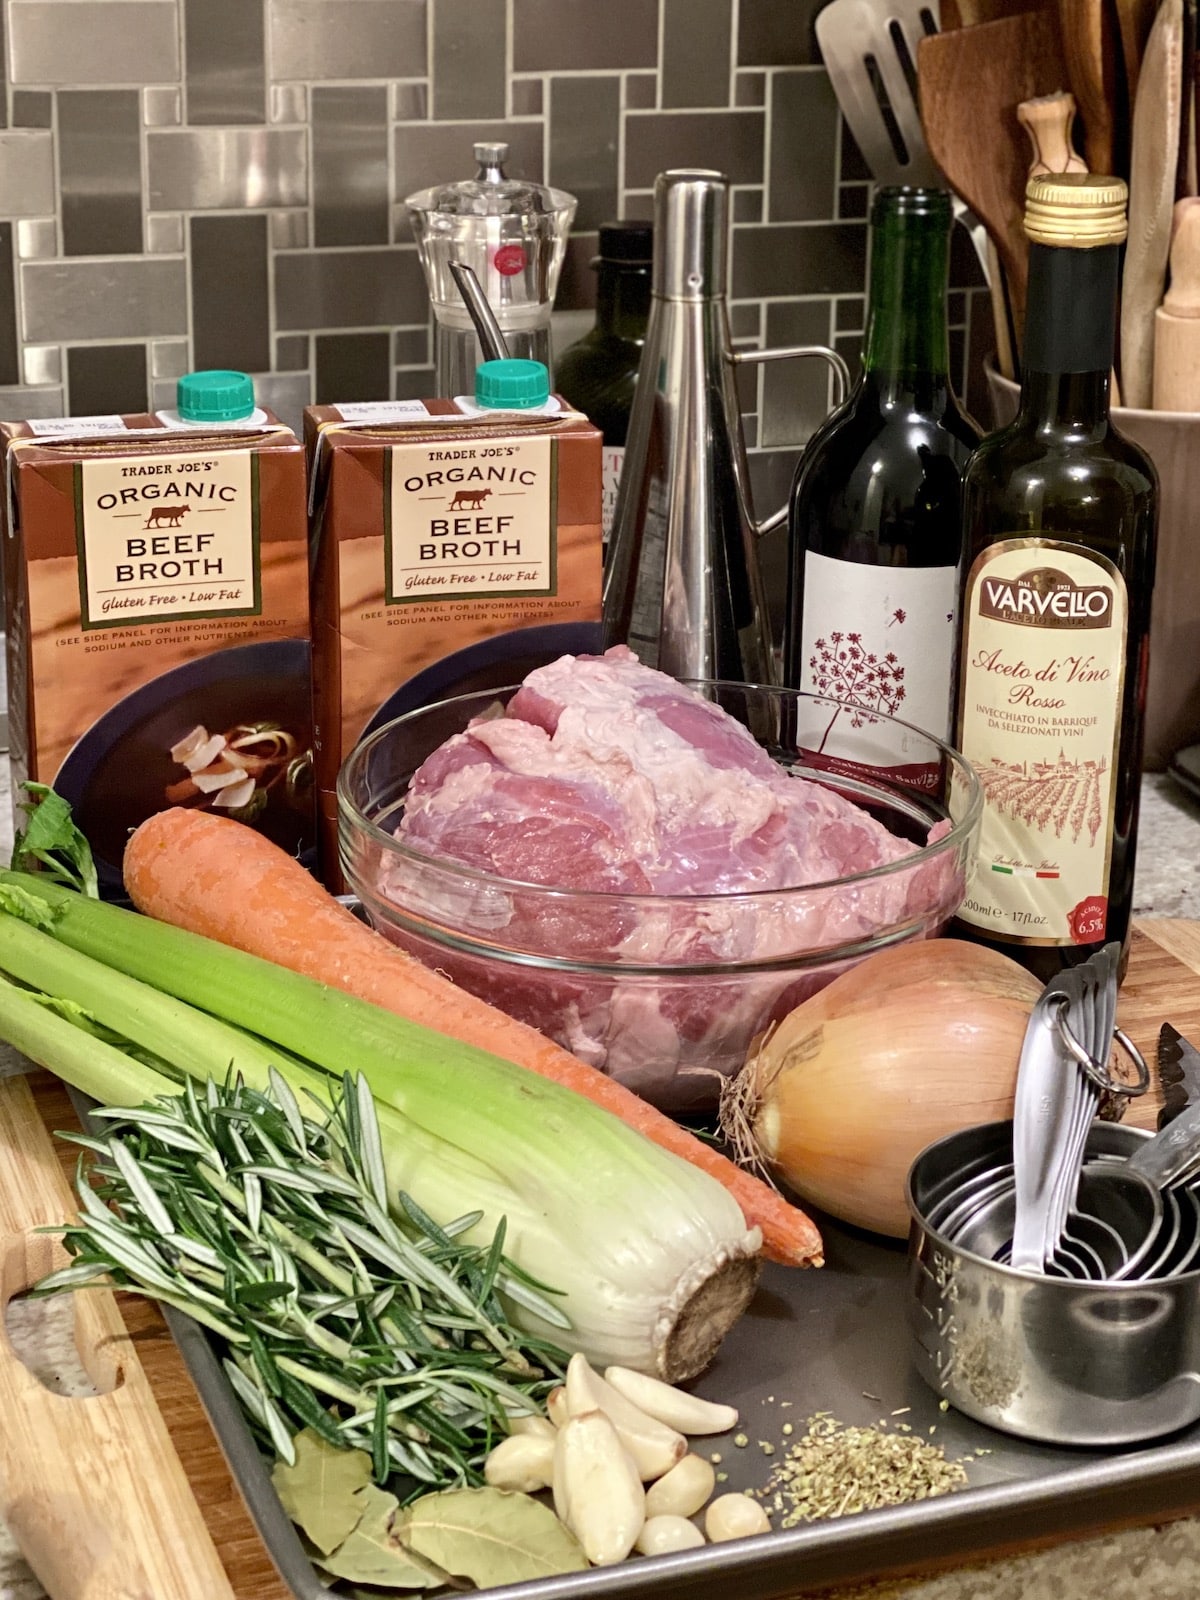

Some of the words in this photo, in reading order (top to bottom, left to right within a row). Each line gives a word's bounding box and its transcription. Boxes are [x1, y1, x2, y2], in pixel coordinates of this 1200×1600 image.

[428, 450, 476, 461] TRADER
[480, 447, 514, 458] JOE'S
[121, 464, 172, 477] TRADER
[177, 461, 213, 473] JOE'S
[404, 466, 537, 492] ORGANIC
[97, 481, 237, 509] ORGANIC
[430, 515, 514, 537] BEEF
[127, 533, 215, 557] BEEF
[419, 539, 521, 561] BROTH
[116, 558, 223, 582] BROTH
[405, 575, 447, 590] Gluten
[450, 573, 477, 584] Free
[488, 571, 514, 582] Low
[516, 570, 539, 581] Fat
[101, 595, 146, 613] Gluten
[149, 593, 177, 605] Free
[189, 591, 216, 602] Low
[218, 588, 242, 600] Fat
[361, 610, 383, 621] (SEE
[386, 608, 409, 617] SIDE
[413, 605, 446, 614] PANEL
[450, 603, 470, 611] FOR
[473, 601, 544, 610] INFORMATION
[547, 600, 582, 608] ABOUT
[986, 581, 1108, 617] VARVELLO
[387, 616, 426, 626] SODIUM
[454, 613, 488, 621] OTHER
[55, 637, 80, 647] (SEE
[84, 633, 109, 643] SIDE
[112, 630, 146, 639] PANEL
[150, 627, 172, 635] FOR
[175, 621, 248, 632] INFORMATION
[252, 619, 288, 627] ABOUT
[84, 642, 127, 653] SODIUM
[129, 639, 152, 648] AND
[155, 635, 191, 645] OTHER
[972, 649, 1032, 679] Aceto
[1035, 659, 1060, 682] di
[1063, 656, 1111, 683] Vino
[1008, 684, 1066, 709] Rosso
[976, 704, 1035, 725] INVECCHIATO
[1038, 716, 1049, 725] IN
[1052, 716, 1098, 727] BARRIQUE
[988, 719, 1000, 729] DA
[1002, 721, 1061, 736] SELEZIONATI
[1063, 728, 1084, 736] VINI
